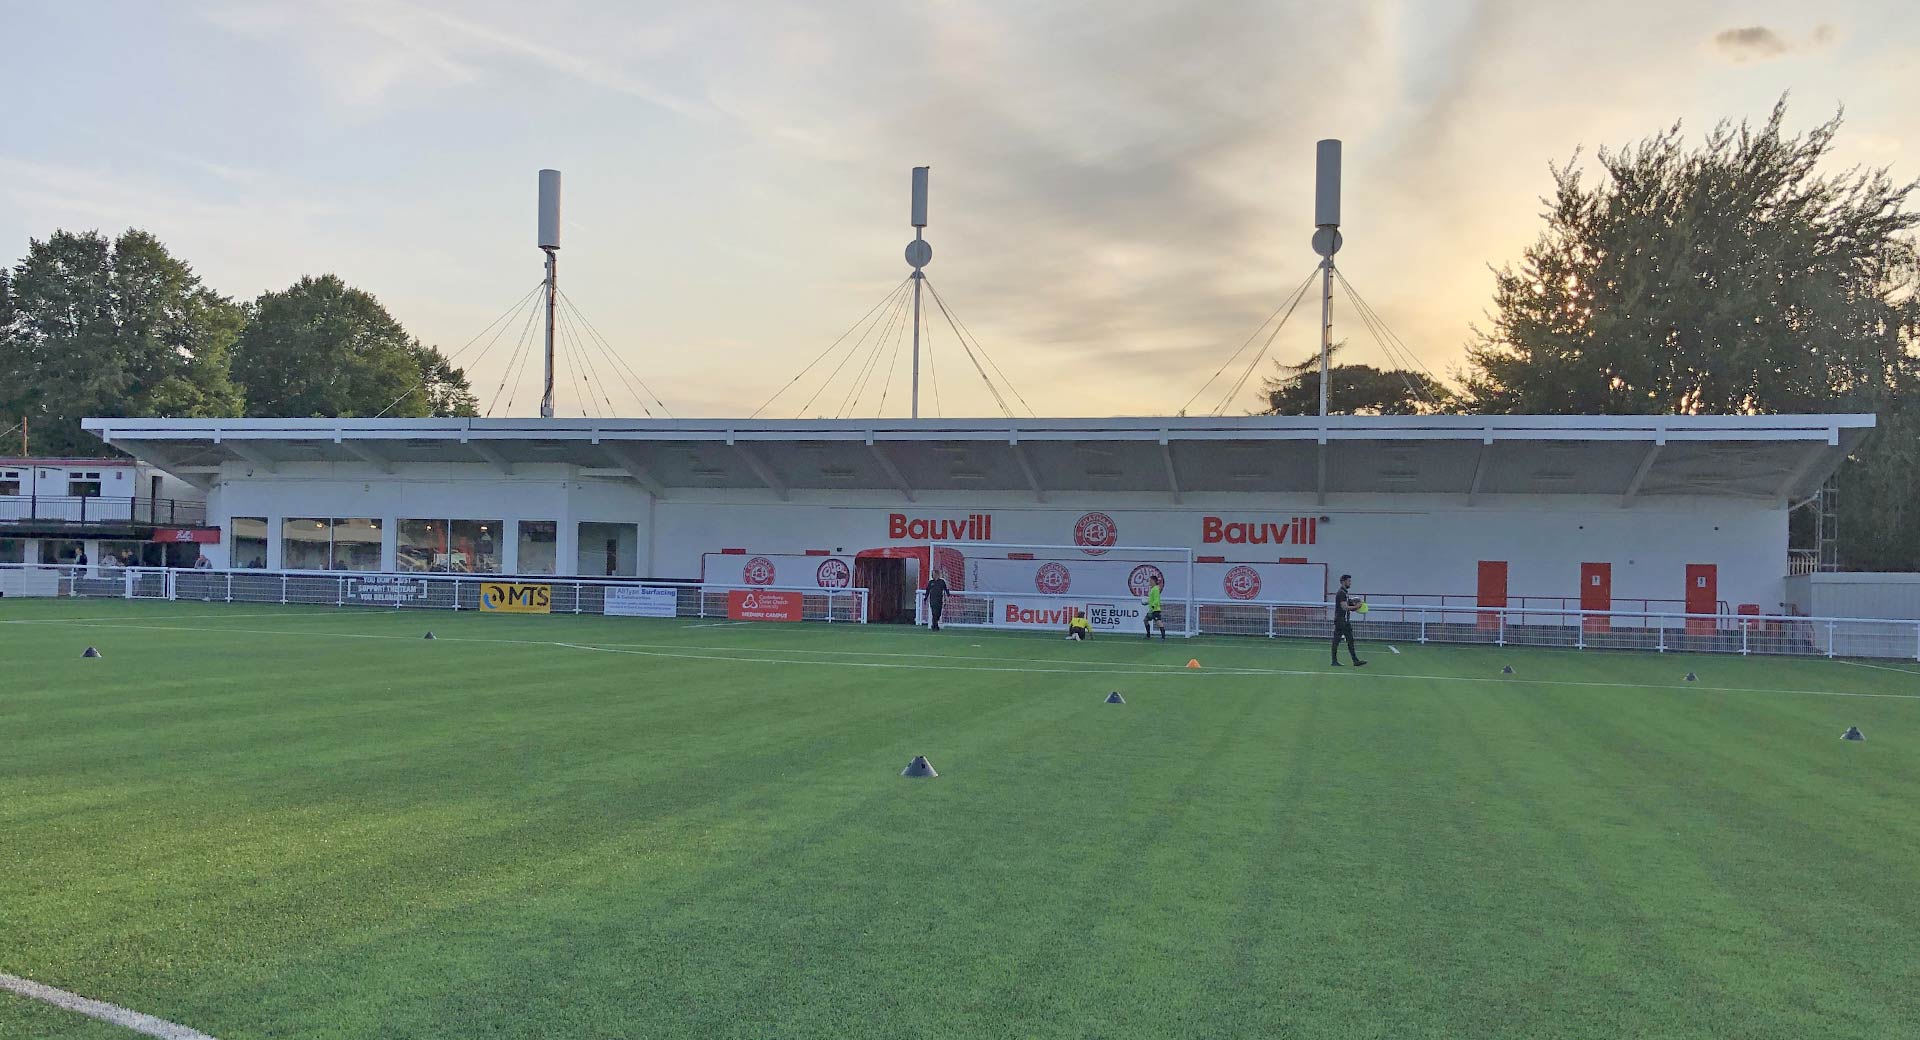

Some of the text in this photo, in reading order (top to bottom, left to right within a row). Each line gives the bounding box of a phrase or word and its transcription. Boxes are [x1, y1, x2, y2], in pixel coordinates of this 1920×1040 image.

[889, 513, 992, 540] Bauvill
[1202, 516, 1317, 544] Bauvill
[508, 586, 549, 607] MTS
[641, 588, 676, 596] Surfacing
[1091, 608, 1139, 618] WE BUILD
[1091, 616, 1121, 625] IDEAS
